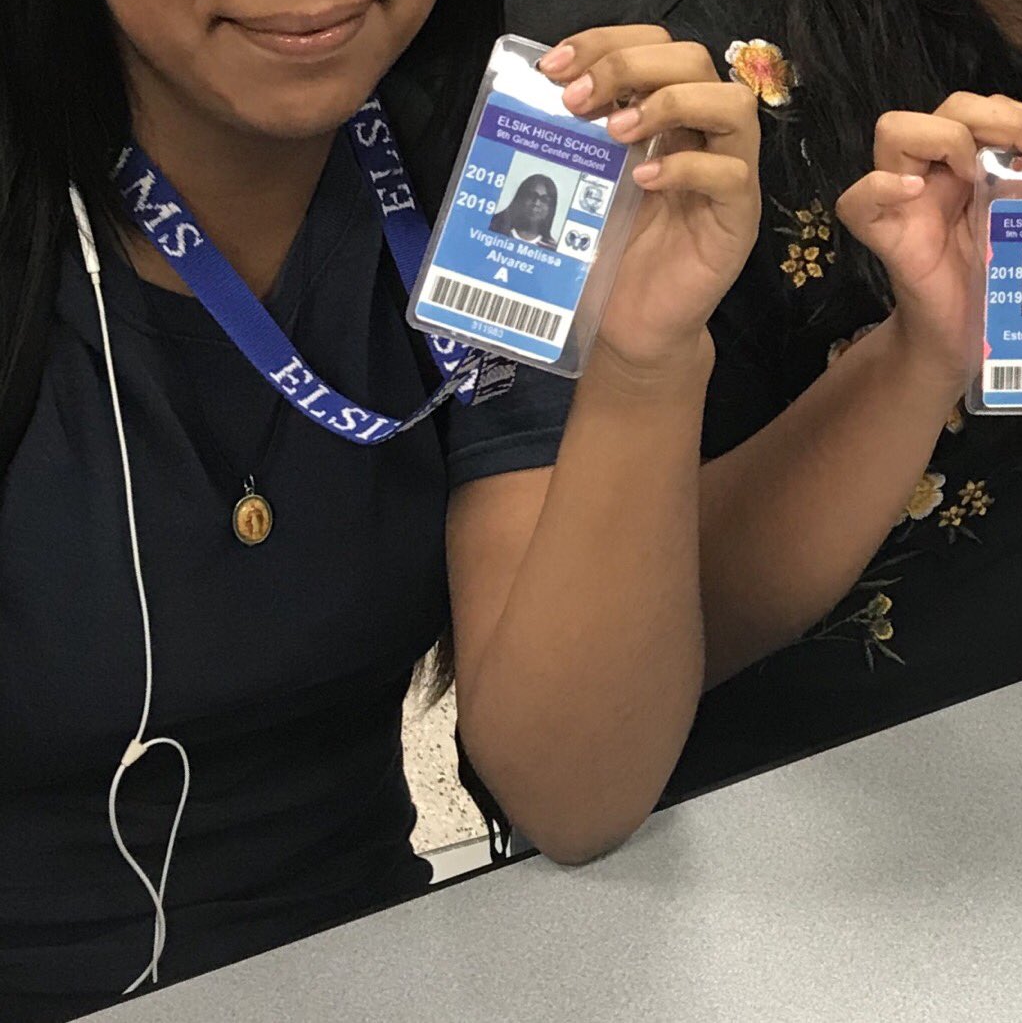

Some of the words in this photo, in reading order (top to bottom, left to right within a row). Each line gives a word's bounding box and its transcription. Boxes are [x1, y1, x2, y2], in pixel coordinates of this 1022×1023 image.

[496, 129, 511, 140] 9th
[512, 135, 539, 150] Grade
[540, 144, 571, 160] Center
[572, 153, 606, 172] Student
[497, 115, 532, 135] ELSIK
[532, 127, 562, 145] HIGH
[563, 137, 611, 161] SCHOOL
[465, 164, 506, 188] 2018
[456, 191, 496, 215] 2019
[469, 227, 515, 252] Virginia
[516, 243, 562, 267] Melissa
[486, 249, 535, 274] Alvarez
[493, 266, 509, 283] A
[989, 291, 1022, 304] 2019
[269, 355, 402, 440] ELSI
